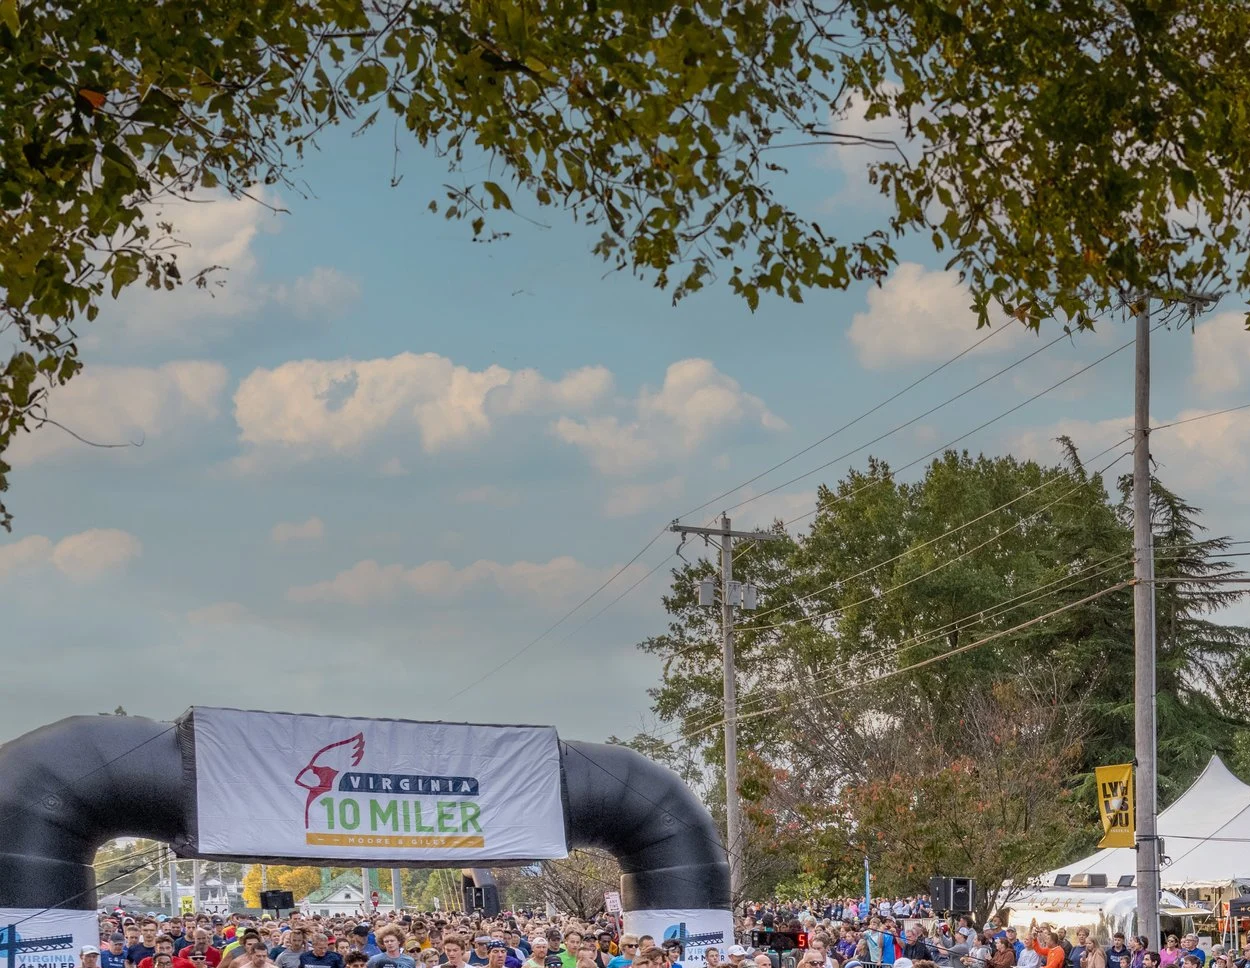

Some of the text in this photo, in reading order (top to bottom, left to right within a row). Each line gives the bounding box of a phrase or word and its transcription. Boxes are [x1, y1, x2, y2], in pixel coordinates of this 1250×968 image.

[350, 776, 471, 792] VIRGINIA
[320, 797, 483, 832] 10 MILER
[18, 955, 75, 963] VIRGINIA
